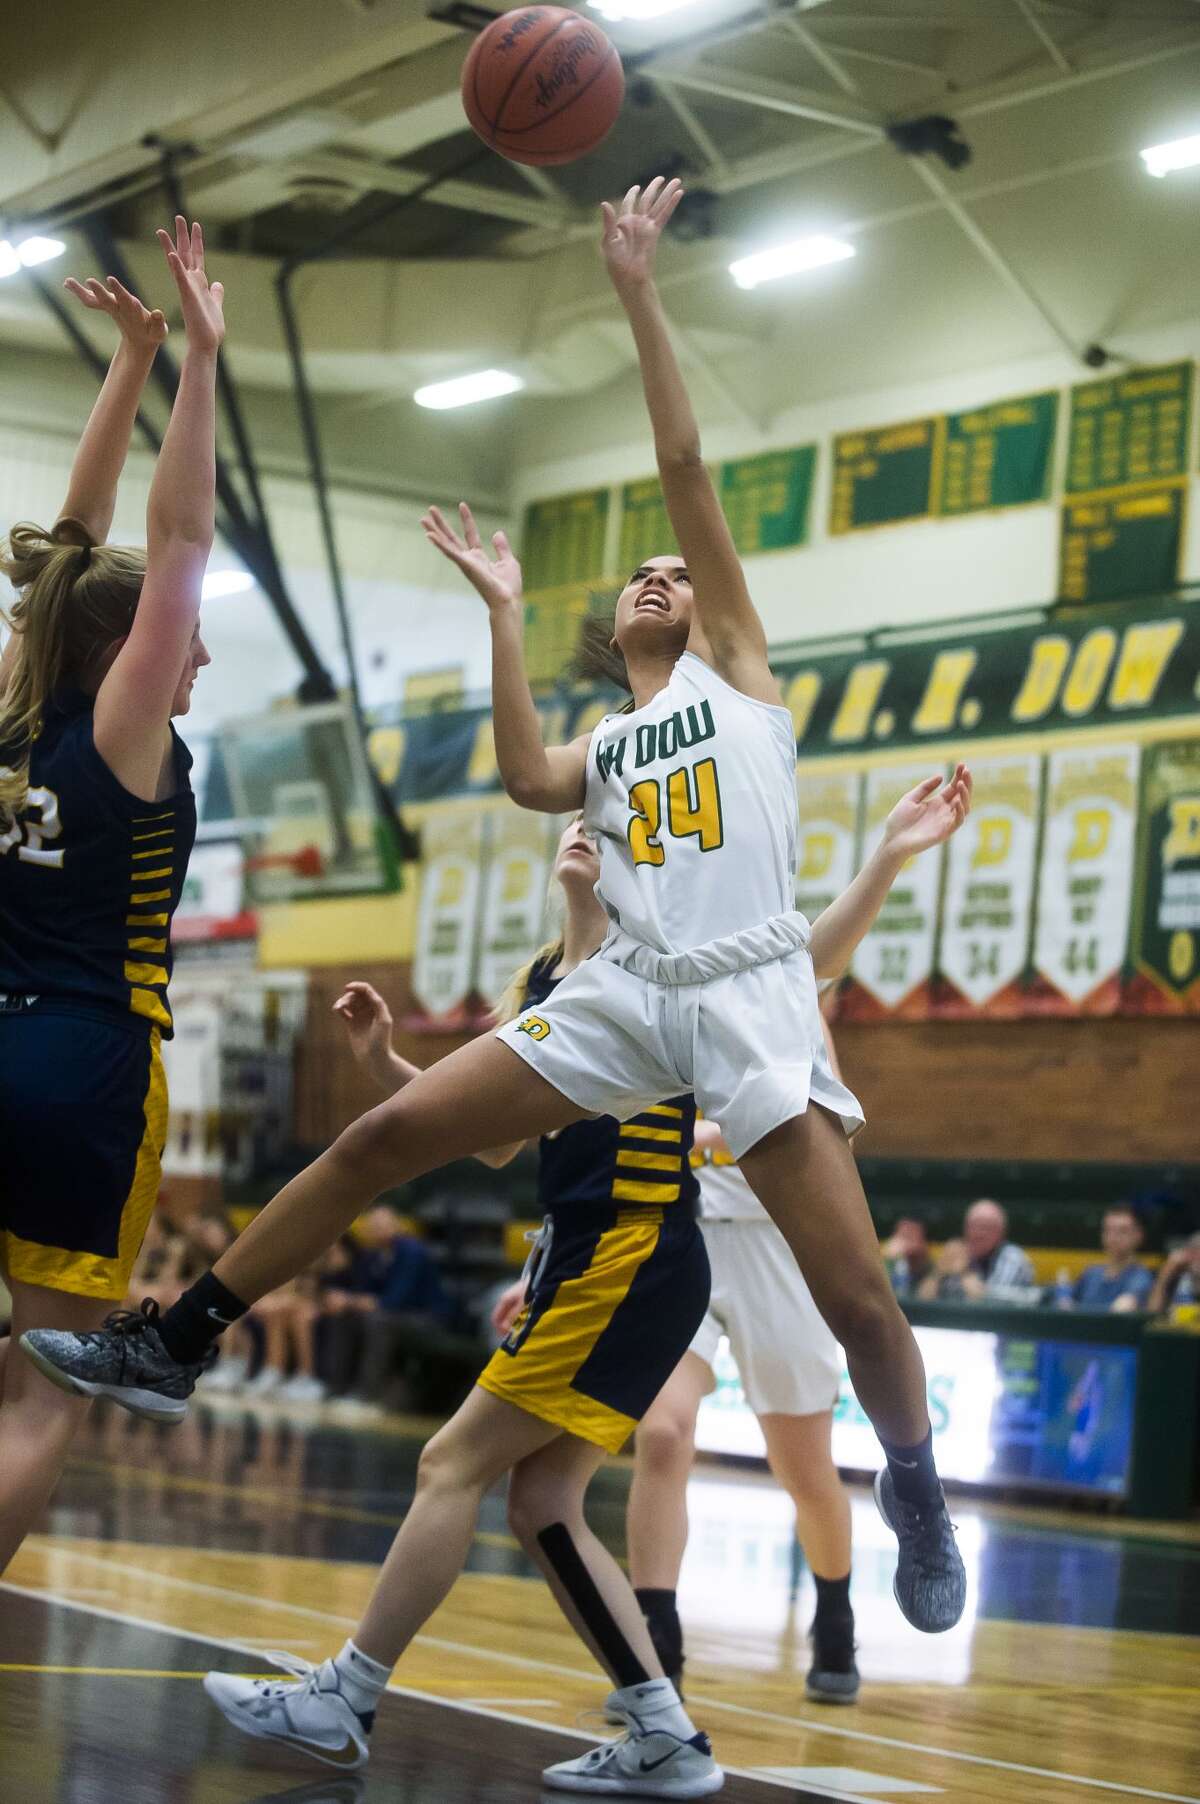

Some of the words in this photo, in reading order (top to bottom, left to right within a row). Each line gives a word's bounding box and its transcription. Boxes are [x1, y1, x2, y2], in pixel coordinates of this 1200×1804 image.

[1011, 620, 1184, 722] DOW
[634, 698, 716, 769] DOW
[0, 785, 66, 868] 2
[627, 757, 724, 867] 24
